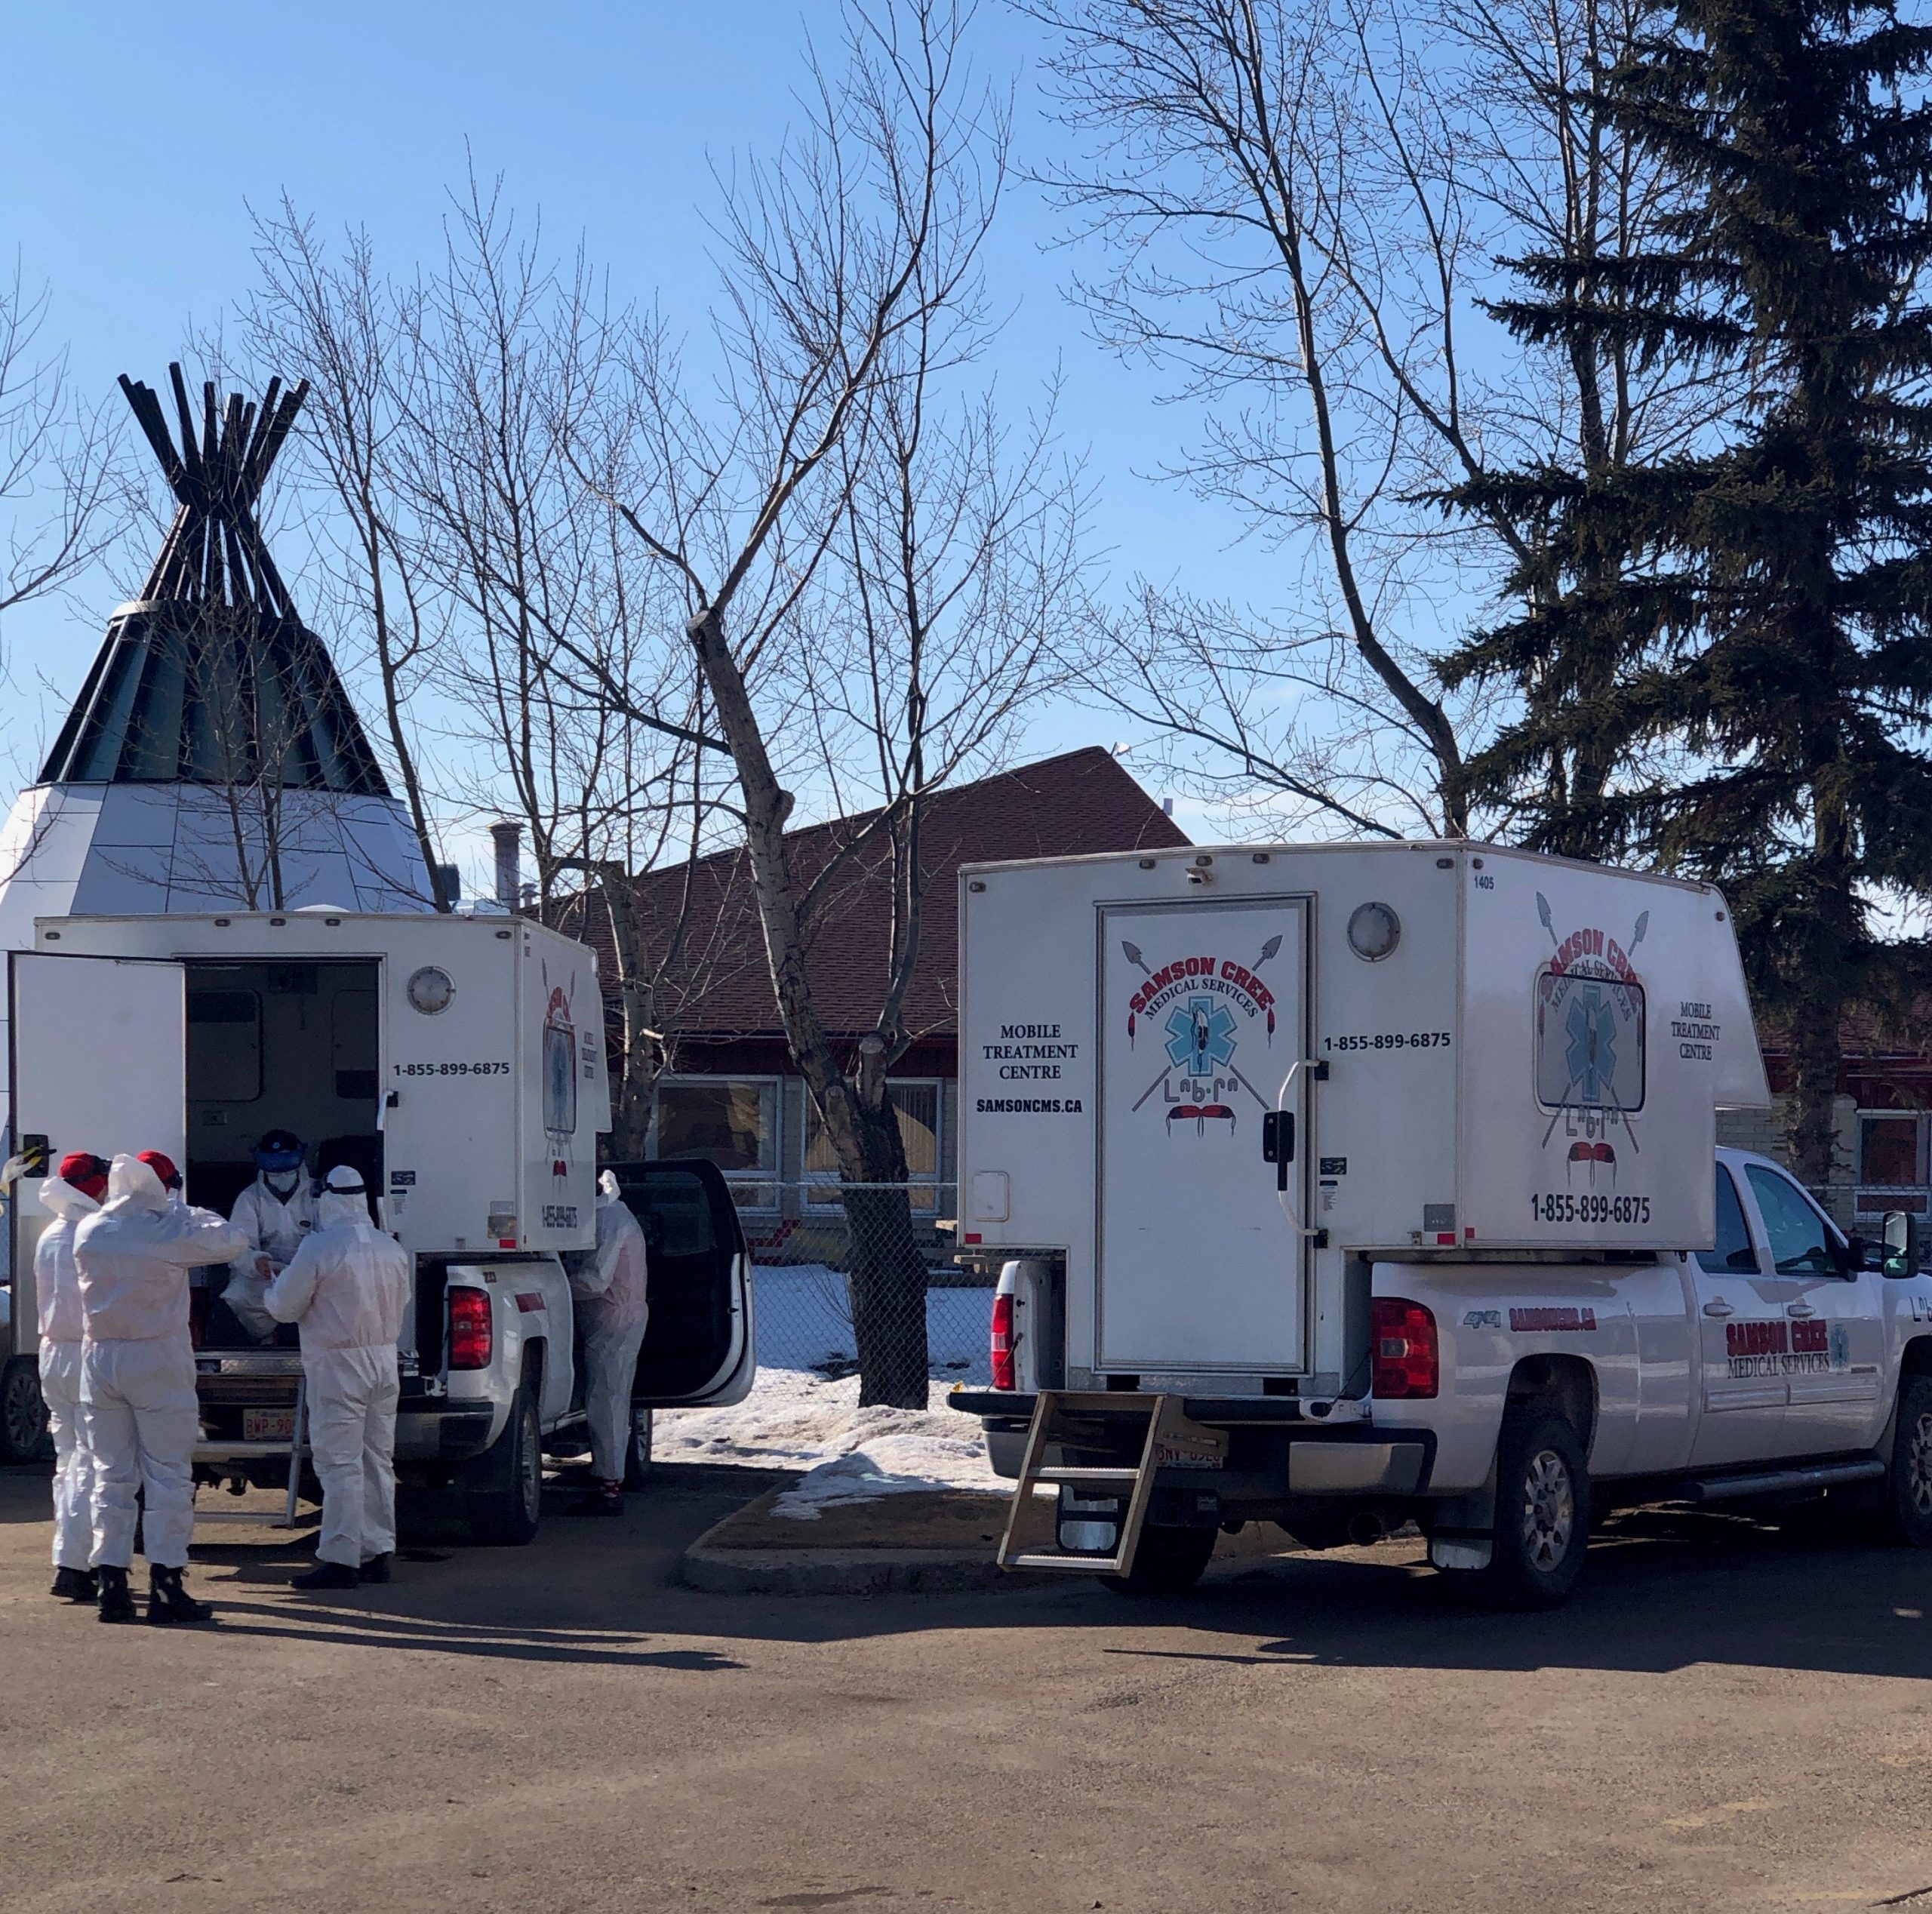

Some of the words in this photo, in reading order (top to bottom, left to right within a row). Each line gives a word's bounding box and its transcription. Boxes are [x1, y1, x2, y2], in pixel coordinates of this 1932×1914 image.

[1474, 875, 1495, 890] 1405
[1130, 957, 1217, 1014] SAMSON
[1220, 961, 1275, 1012] CREE
[1144, 979, 1199, 1021] MEDICAL
[1201, 978, 1259, 1018] SERVICES
[1680, 1002, 1712, 1020] MOBILE
[1000, 1024, 1061, 1039] MOBILE
[1671, 1021, 1721, 1041] TREATMENT
[1324, 1032, 1451, 1051] 1-855-899-6875
[983, 1045, 1079, 1060] TREATMENT
[1679, 1043, 1712, 1060] CENTRE
[393, 1062, 510, 1076] 1-855-899-6875
[999, 1065, 1062, 1080] CENTRE
[976, 1099, 1083, 1113] SAMSONCMS.CA
[1531, 1193, 1651, 1224] 1-855-899-6875
[1726, 1321, 1789, 1357] SAMSON
[1727, 1358, 1780, 1379] MEDICAL
[1781, 1353, 1830, 1375] SERVICES
